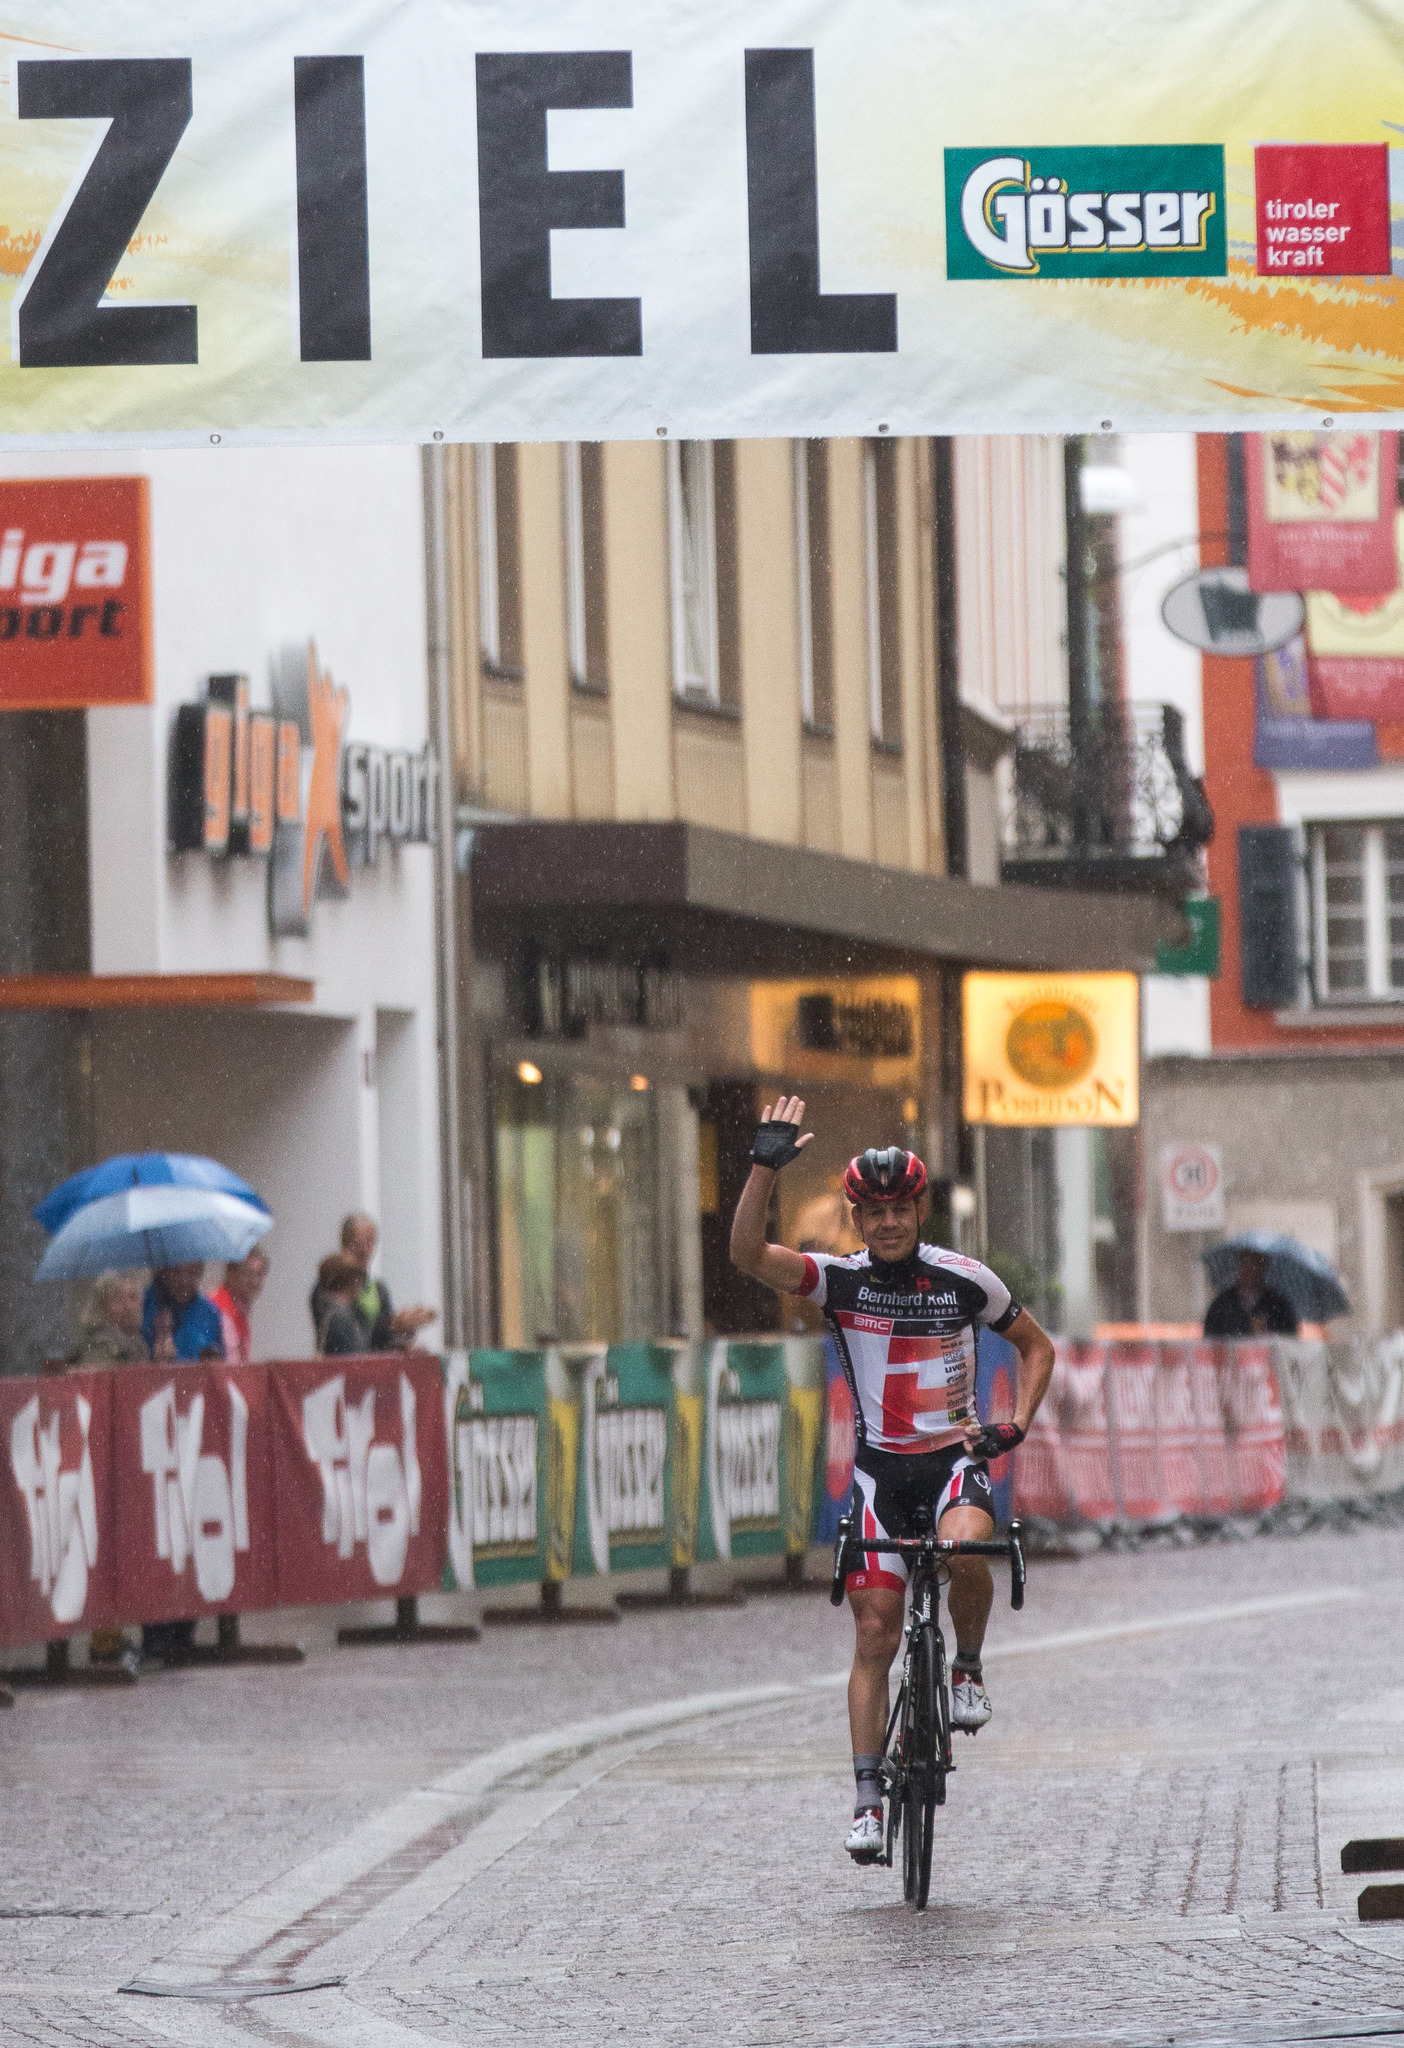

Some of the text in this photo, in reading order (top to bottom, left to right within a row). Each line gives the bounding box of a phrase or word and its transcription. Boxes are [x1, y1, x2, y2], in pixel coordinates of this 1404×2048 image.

[18, 47, 898, 367] ZIEL
[960, 154, 1215, 274] Gösser
[1266, 198, 1341, 220] tiroler
[1267, 225, 1351, 243] wasser
[1267, 245, 1324, 267] kraft
[857, 1286, 958, 1306] Bernhard Kohl
[856, 1303, 904, 1316] FAHRRAD
[917, 1307, 959, 1315] FITNESS
[854, 1315, 890, 1331] BMC
[942, 1539, 954, 1549] 3T
